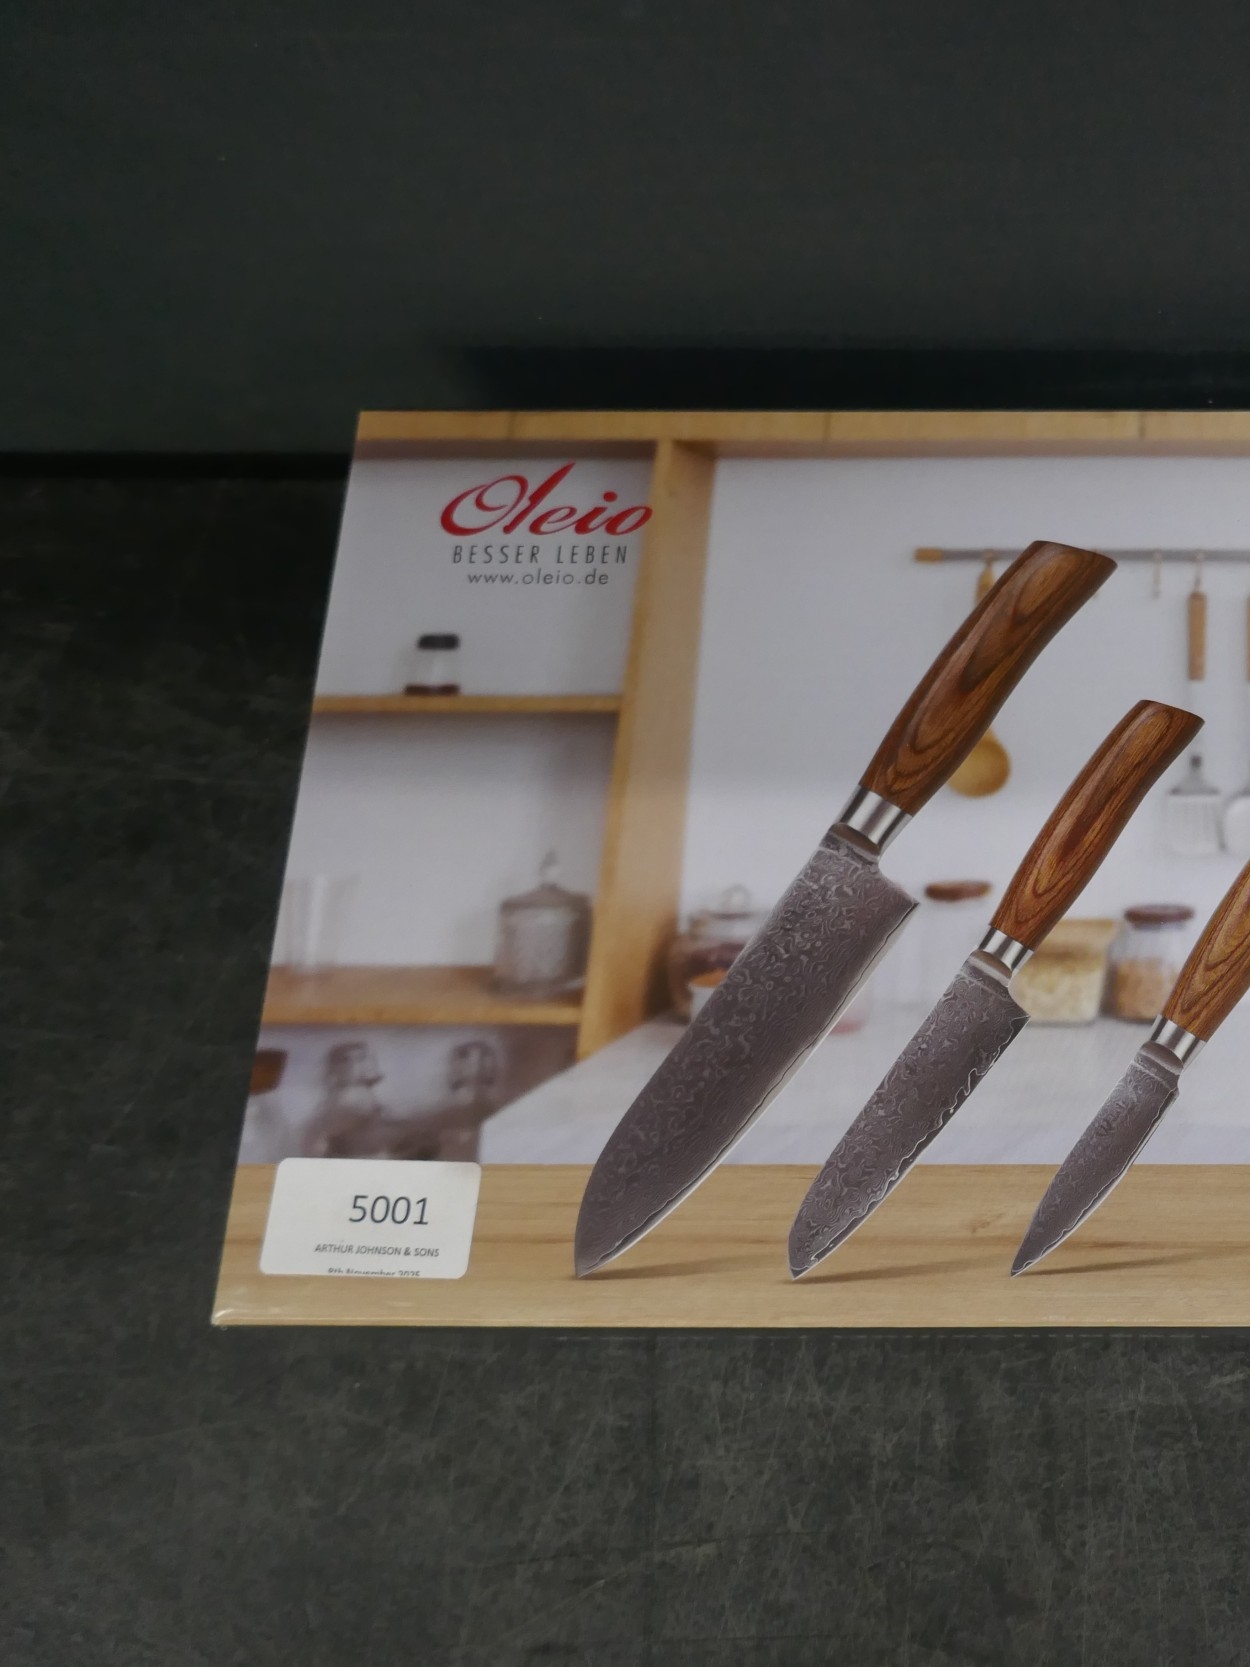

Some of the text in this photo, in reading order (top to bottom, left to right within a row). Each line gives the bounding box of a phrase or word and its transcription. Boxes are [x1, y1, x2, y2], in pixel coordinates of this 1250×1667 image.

[440, 460, 654, 537] Oleio
[452, 544, 629, 565] BESSER LEBEN
[467, 567, 610, 586] www.oleio.de
[348, 1194, 430, 1226] 5001
[314, 1243, 440, 1258] ARTHUR JOHNSON & SONS
